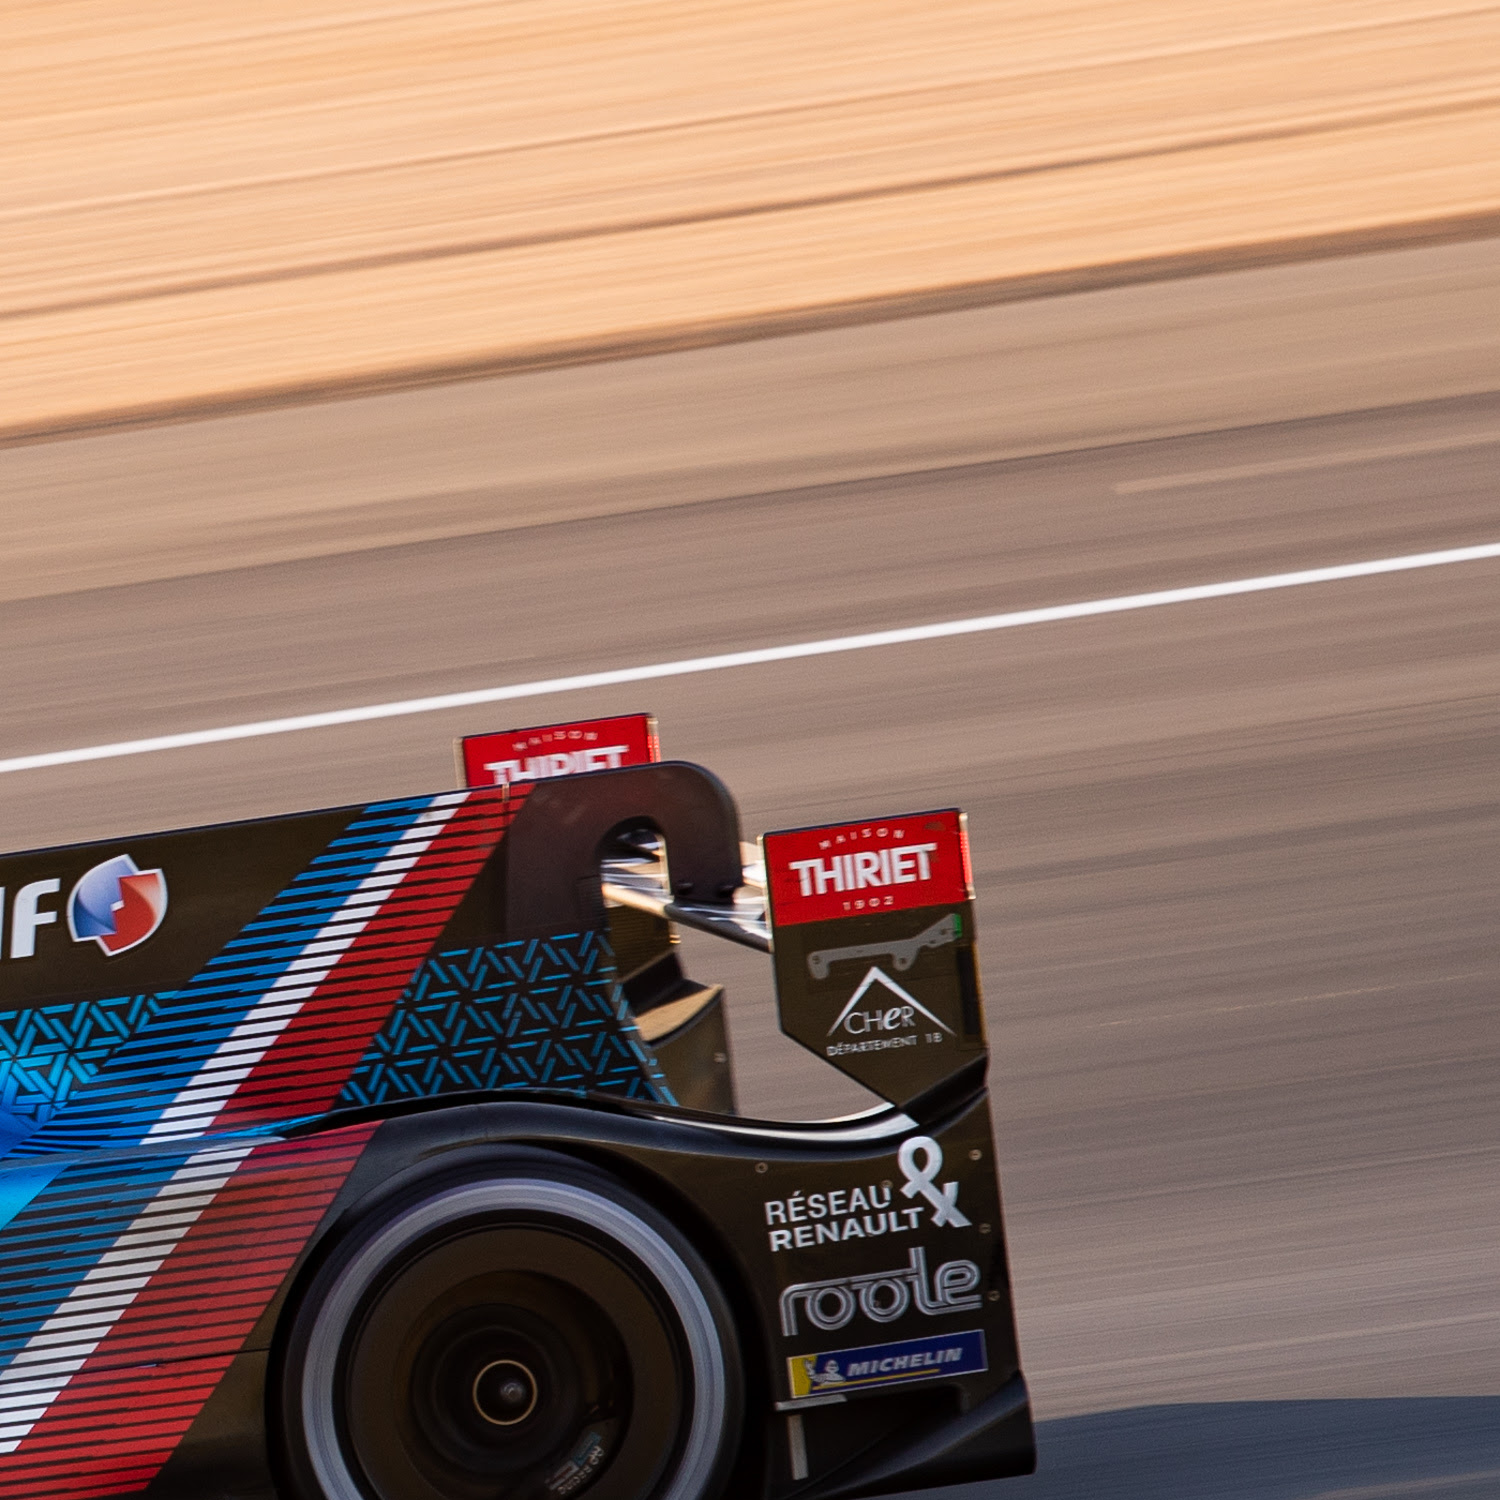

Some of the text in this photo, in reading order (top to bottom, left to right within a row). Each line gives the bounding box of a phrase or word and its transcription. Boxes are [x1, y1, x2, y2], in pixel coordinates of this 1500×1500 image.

[819, 827, 905, 850] MAISON
[788, 843, 938, 897] THIRIET
[843, 896, 895, 911] 1902
[826, 1035, 918, 1056] DÉPARTEMENT
[764, 1184, 891, 1226] RÉSEAU
[768, 1206, 924, 1252] RENAULT
[779, 1246, 983, 1337] roole
[847, 1348, 963, 1377] MICHELIN
